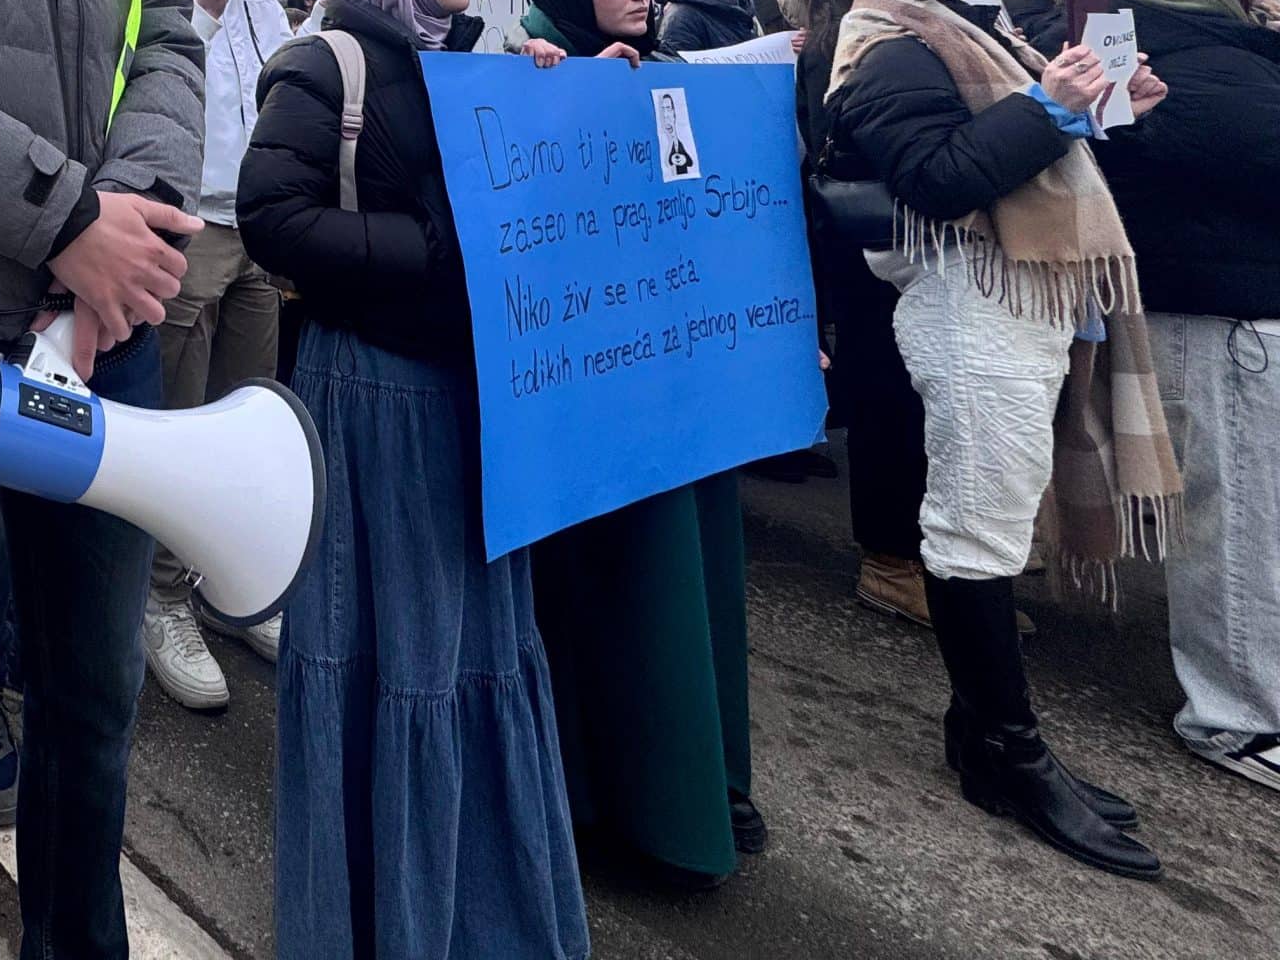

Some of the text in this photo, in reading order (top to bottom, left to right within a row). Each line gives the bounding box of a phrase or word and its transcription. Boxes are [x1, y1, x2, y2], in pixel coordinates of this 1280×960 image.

[475, 106, 654, 190] Davno ti je vrag
[499, 212, 566, 254] zaseo
[576, 209, 599, 236] na
[657, 190, 696, 230] zemljo
[504, 273, 551, 340] Niko
[563, 280, 592, 322] živ
[604, 282, 628, 306] se
[637, 277, 659, 303] ne
[583, 328, 656, 377] nesreća
[662, 324, 682, 355] za
[685, 304, 737, 358] jednog
